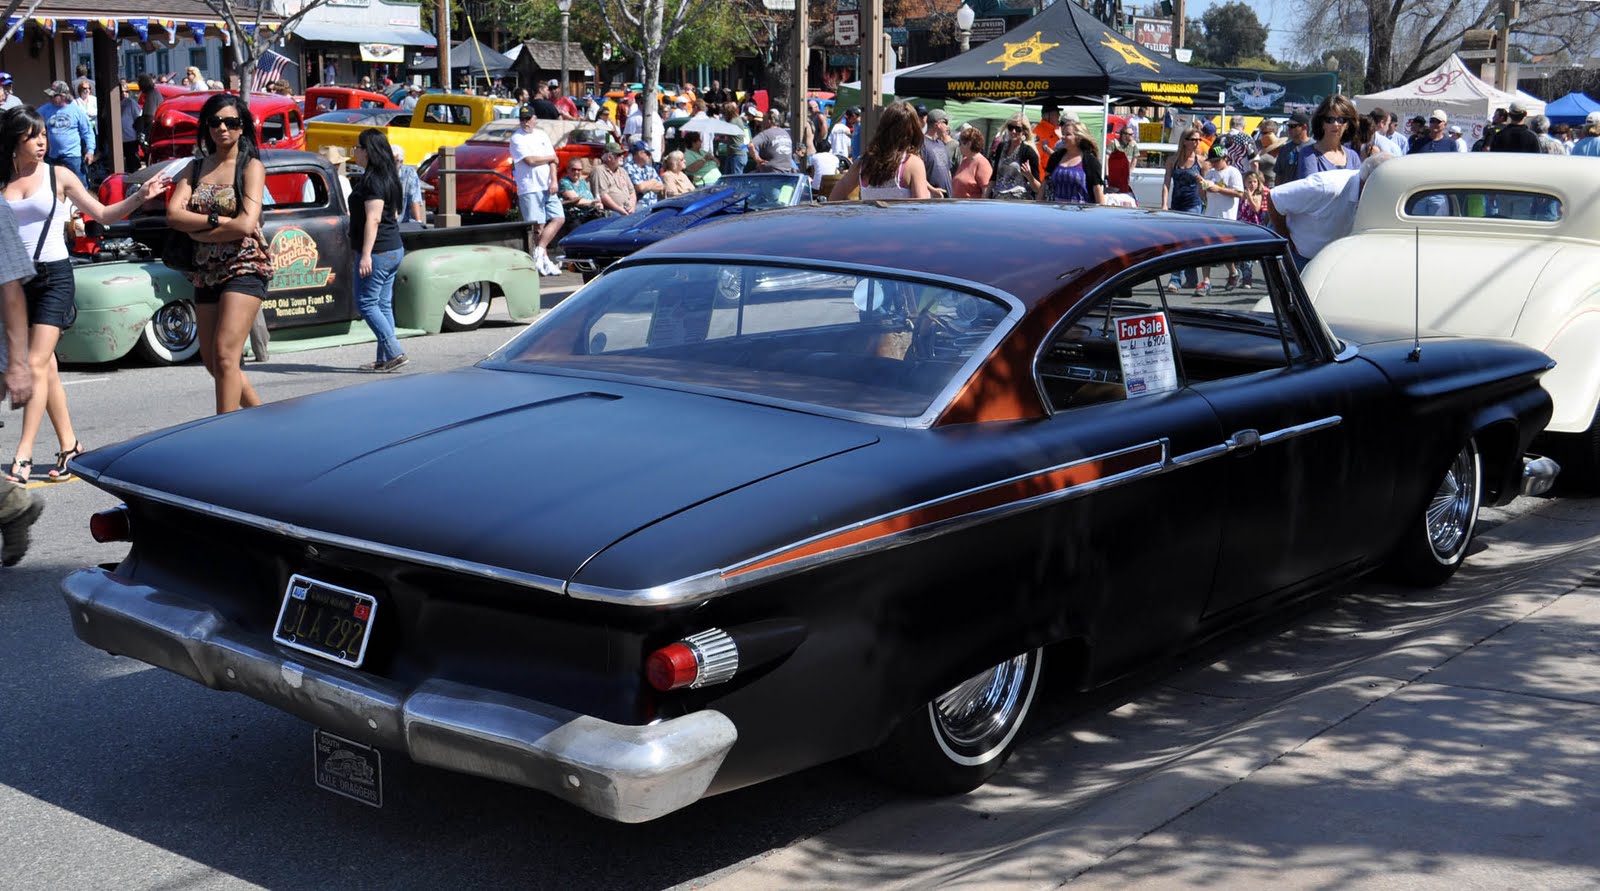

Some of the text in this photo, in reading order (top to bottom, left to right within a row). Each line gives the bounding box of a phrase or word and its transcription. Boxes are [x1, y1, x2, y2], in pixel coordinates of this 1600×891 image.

[1143, 23, 1155, 33] OLD
[947, 80, 1050, 91] WWW.JOINRSD.ORG
[1140, 82, 1199, 94] WWW.JOINRSD.ORG
[279, 233, 304, 253] Body
[278, 297, 289, 308] Old
[290, 297, 307, 307] Town
[308, 295, 325, 306] Front
[275, 306, 306, 317] Temecula
[1120, 319, 1162, 338] For Sale
[283, 603, 363, 656] JLA 292
